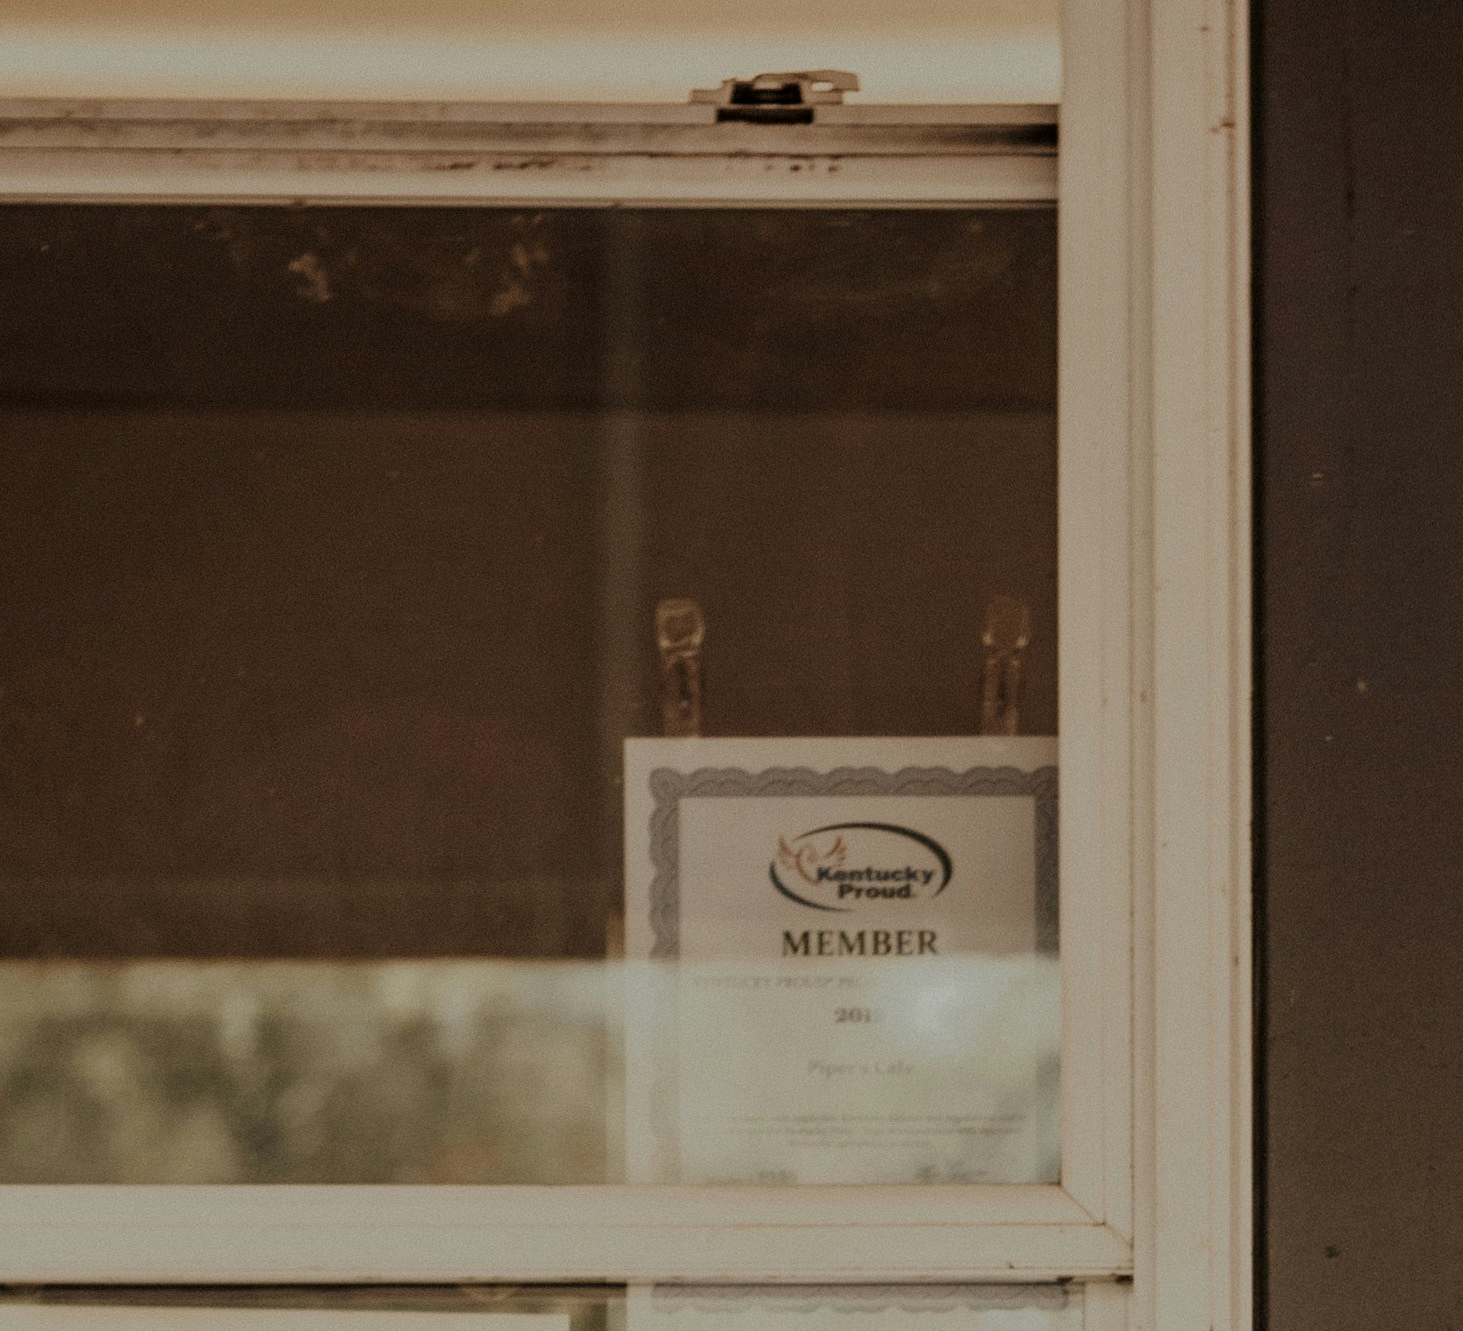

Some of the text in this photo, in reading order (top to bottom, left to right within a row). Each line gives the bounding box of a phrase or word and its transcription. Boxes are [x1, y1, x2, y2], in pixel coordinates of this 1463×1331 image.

[816, 866, 935, 886] Kentucky
[838, 883, 912, 899] Proud
[782, 929, 937, 957] MEMBER
